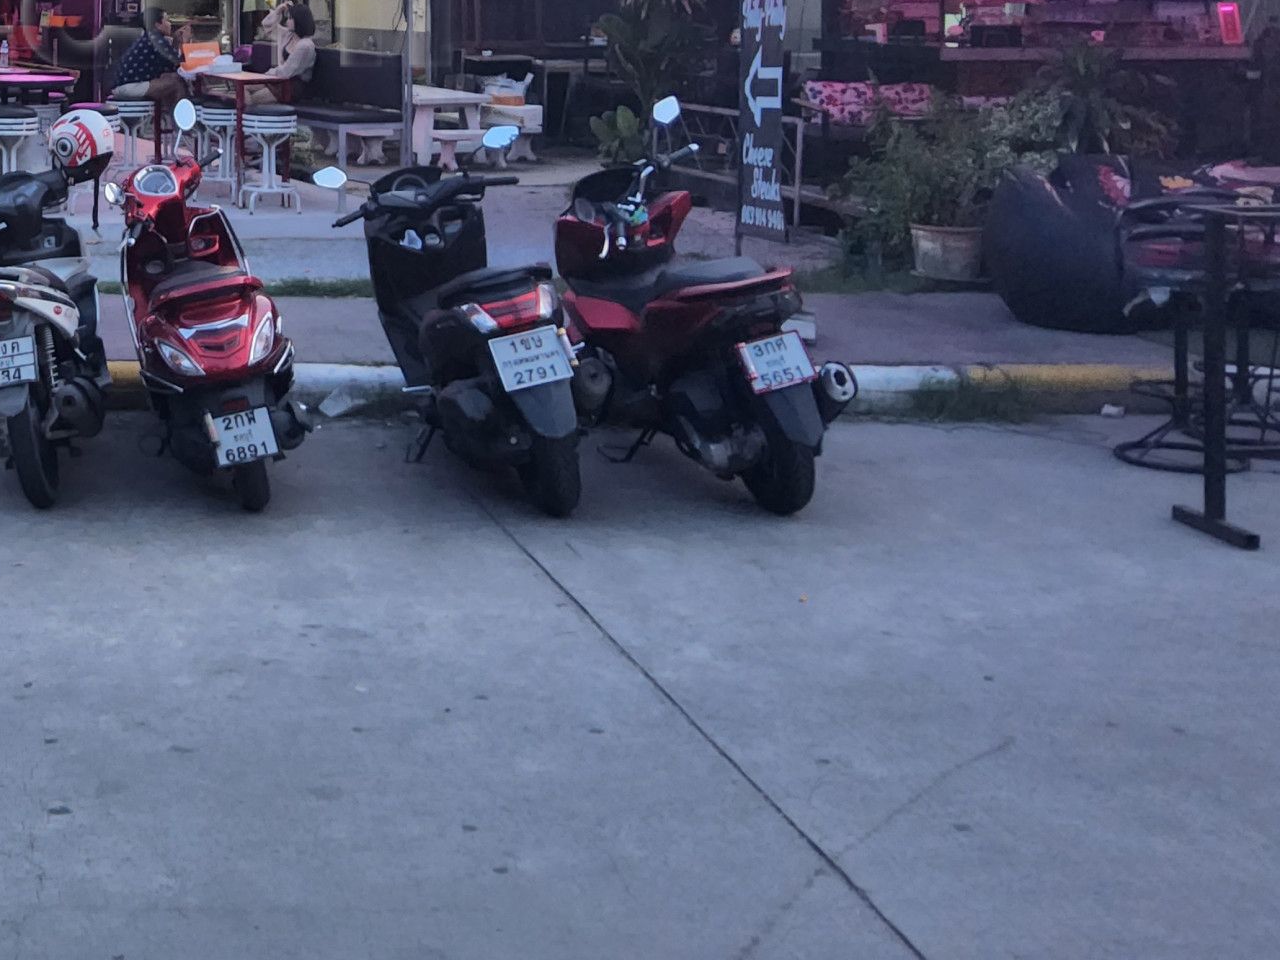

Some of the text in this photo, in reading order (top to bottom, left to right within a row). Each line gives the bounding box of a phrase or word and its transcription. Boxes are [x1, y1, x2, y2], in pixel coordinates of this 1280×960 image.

[742, 132, 774, 167] Cheese
[513, 364, 558, 385] 2791
[760, 365, 804, 386] 5651
[225, 440, 269, 462] 6891
